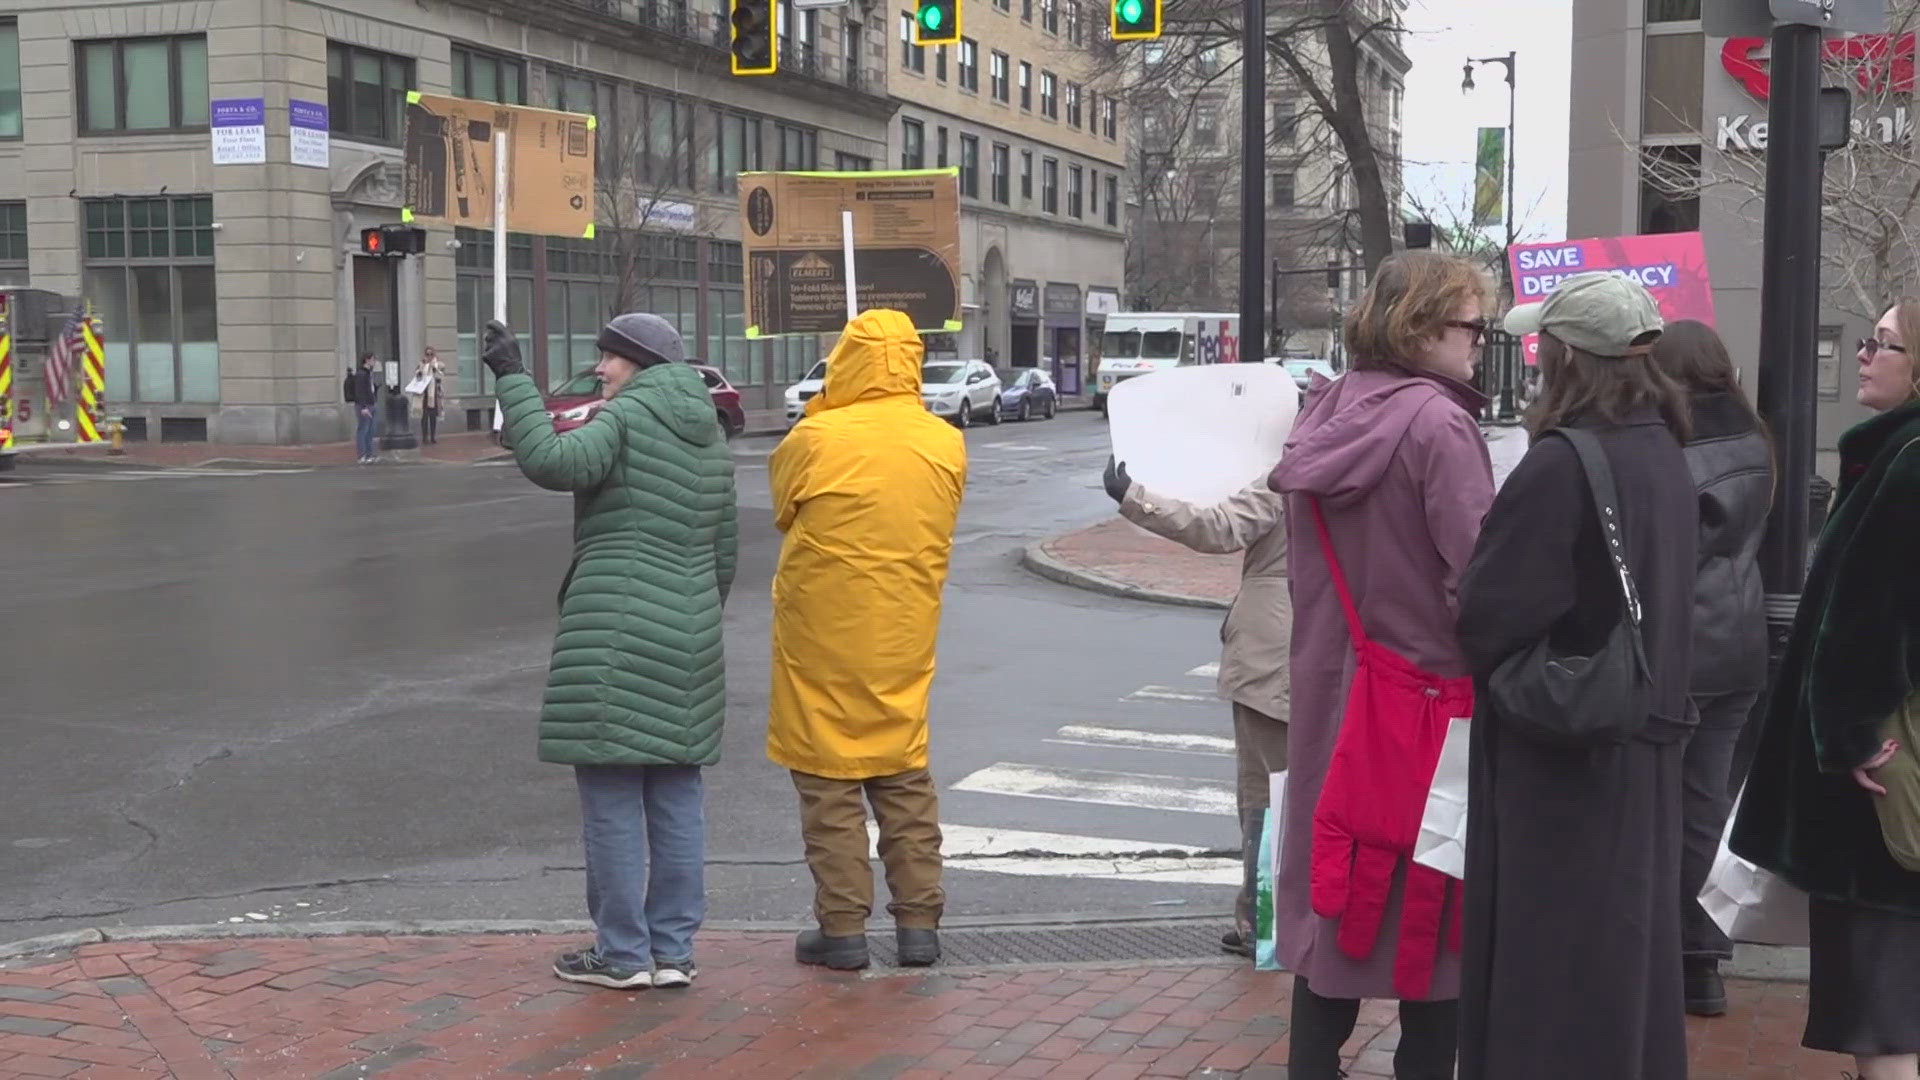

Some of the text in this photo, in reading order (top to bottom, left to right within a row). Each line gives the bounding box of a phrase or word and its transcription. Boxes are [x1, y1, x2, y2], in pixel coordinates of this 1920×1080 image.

[235, 127, 259, 135] LEASE
[1519, 247, 1580, 269] SAVE
[792, 268, 830, 277] ELMER'S
[1198, 320, 1239, 364] FedEx
[18, 399, 31, 422] 5
